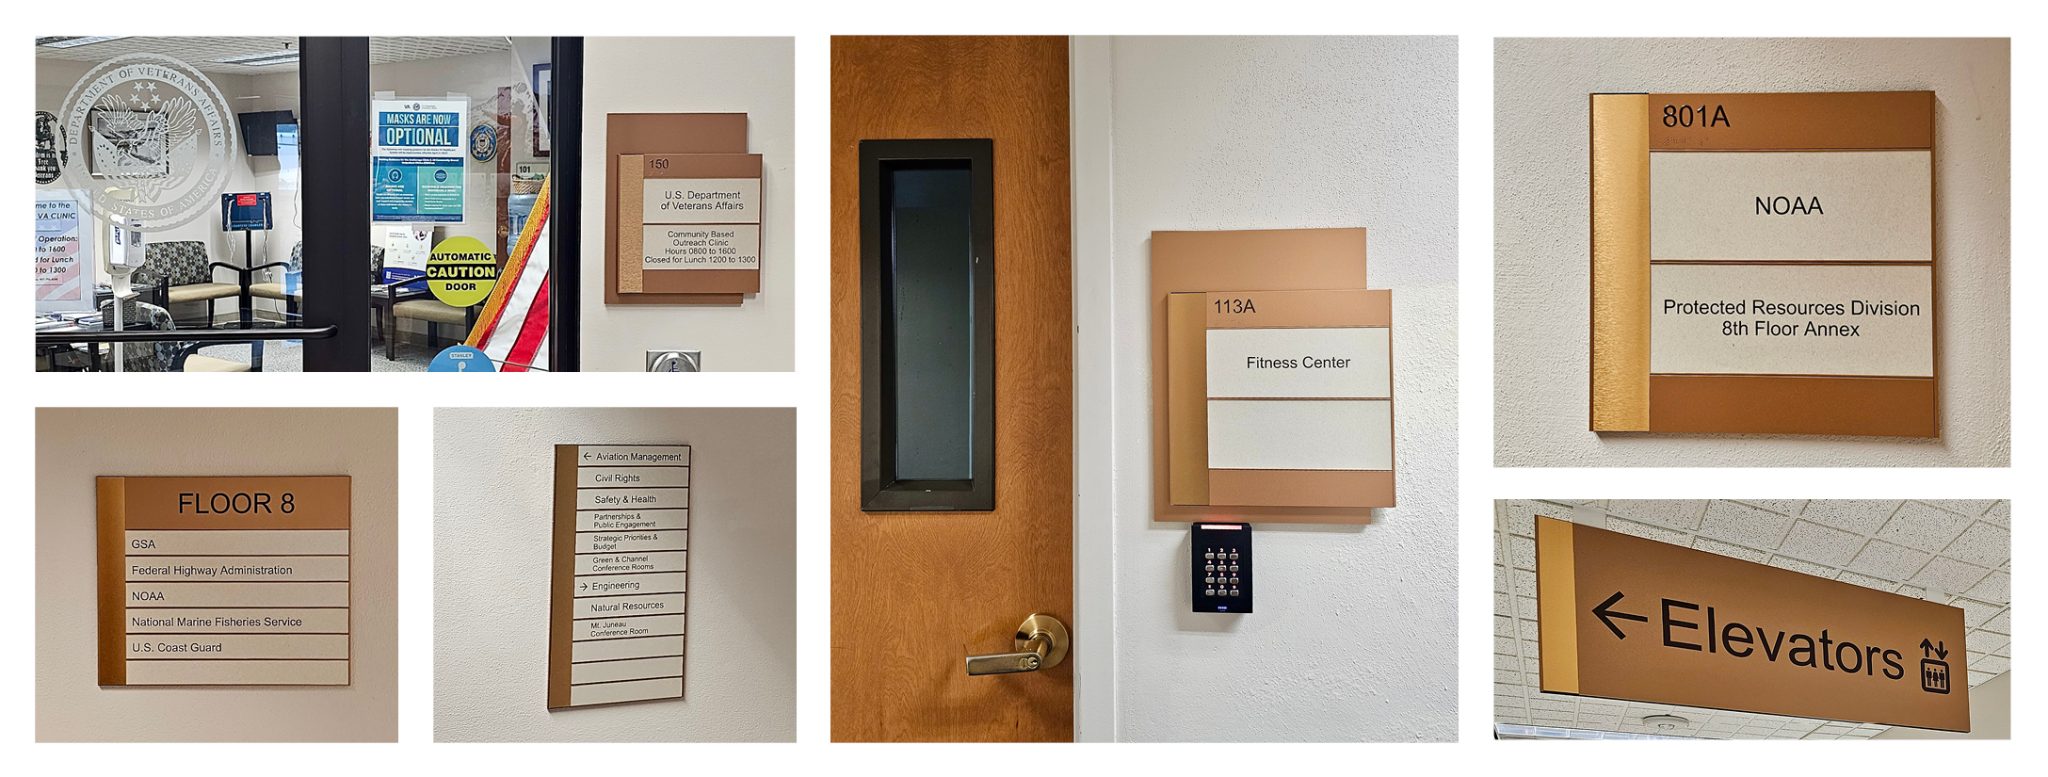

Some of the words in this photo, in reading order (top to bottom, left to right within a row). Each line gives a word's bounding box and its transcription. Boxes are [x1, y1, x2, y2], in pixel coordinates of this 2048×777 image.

[69, 74, 115, 145] DEPARTMENT
[119, 67, 133, 79] OF
[138, 66, 200, 97] VETERANS
[199, 98, 223, 147] AFFAIRS
[386, 113, 415, 125] MASKS
[415, 113, 432, 125] ARE
[432, 113, 451, 125] NOW
[1662, 104, 1731, 129] 801A
[386, 127, 452, 146] OPTIONAL
[519, 165, 531, 173] 101
[648, 158, 670, 169] 150
[665, 190, 685, 200] U.S.
[687, 190, 741, 201] Department
[160, 206, 175, 217] OF
[660, 202, 670, 210] of
[672, 202, 713, 210] Veterans
[715, 202, 744, 210] Affairs
[1755, 196, 1824, 216] NOAA
[38, 234, 78, 243] Operation:
[667, 230, 709, 239] Community
[711, 230, 735, 238] Based
[665, 247, 687, 255] Hours
[688, 247, 708, 255] 0800
[718, 247, 737, 255] 1600
[430, 253, 491, 261] AUTOMATIC
[427, 266, 496, 278] CAUTION
[445, 282, 476, 291] DOOR
[1214, 299, 1256, 314] 113A
[1663, 299, 1746, 316] Protected
[1752, 299, 1845, 316] Resources
[1850, 300, 1920, 317] Division
[1722, 321, 1749, 337] 8th
[1754, 320, 1799, 337] Floor
[1803, 321, 1860, 338] Annex
[1246, 356, 1298, 369] Fitness
[1302, 356, 1351, 369] Center
[596, 453, 629, 461] Aviation
[630, 453, 682, 463] Management
[595, 474, 613, 483] Civil
[614, 474, 641, 484] Rights
[178, 492, 273, 515] FLOOR
[280, 492, 295, 514] 8
[594, 495, 621, 506] Safety
[622, 495, 629, 504] &
[631, 494, 657, 504] Health
[594, 513, 635, 521] Partnerships
[593, 521, 614, 529] Public
[615, 520, 656, 530] Engagement
[593, 534, 622, 543] Strategic
[623, 534, 652, 542] Priorities
[653, 533, 658, 541] &
[131, 539, 156, 550] GSA
[593, 543, 617, 551] Budget
[592, 556, 613, 564] Green
[621, 555, 649, 563] Channel
[131, 565, 171, 575] Federal
[173, 565, 218, 578] Highway
[219, 565, 293, 575] Administration
[592, 564, 631, 572] Conference
[632, 563, 654, 571] Rooms
[592, 580, 640, 592] Engineering
[132, 591, 165, 601] NOAA
[590, 602, 621, 612] Natural
[622, 601, 665, 611] Resources
[131, 617, 174, 627] National
[177, 617, 212, 627] Marine
[215, 617, 261, 627] Fisheries
[263, 617, 302, 627] Service
[590, 622, 602, 630] Mt.
[590, 629, 628, 638] Conference
[629, 628, 649, 636] Room
[1660, 597, 1905, 681] Elevators
[131, 642, 155, 653] U.S.
[157, 642, 187, 653] Coast
[190, 642, 222, 653] Guard
